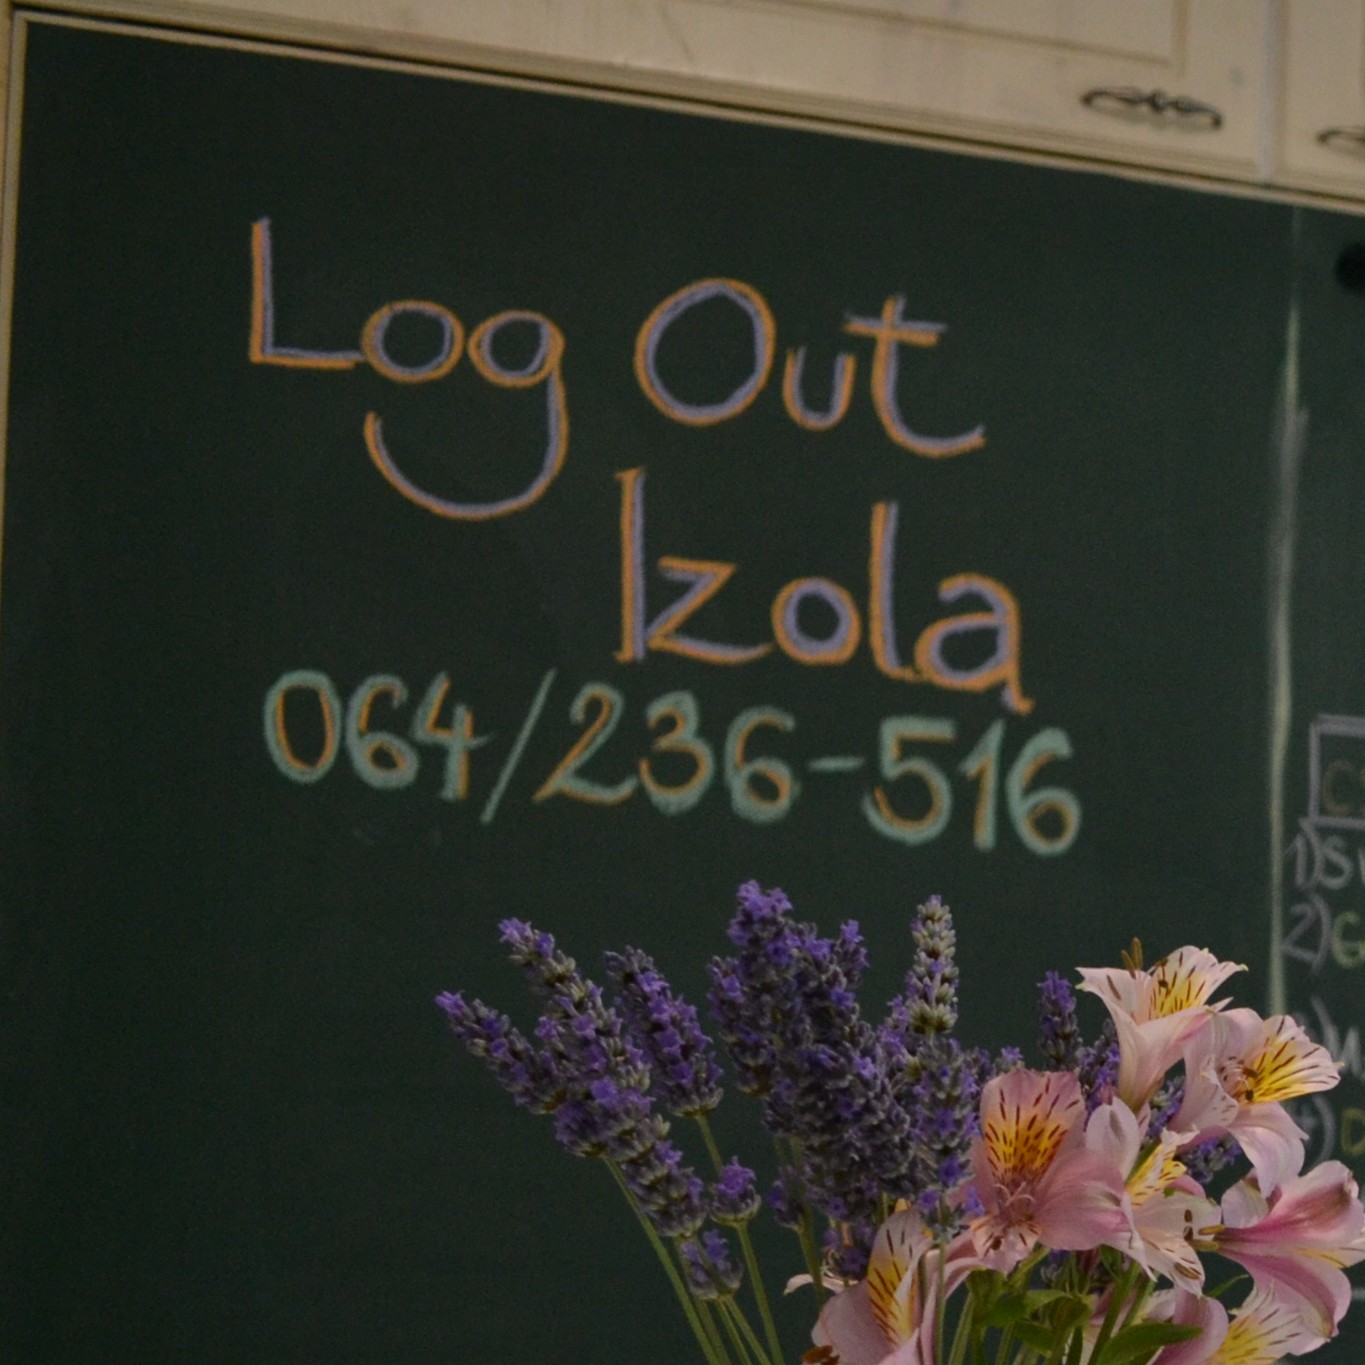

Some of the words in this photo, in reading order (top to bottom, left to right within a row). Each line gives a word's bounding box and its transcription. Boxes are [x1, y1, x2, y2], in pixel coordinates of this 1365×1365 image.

[251, 217, 568, 519] Log
[633, 277, 985, 458] Out
[616, 466, 1035, 715] Izola
[264, 668, 1082, 857] 064/236-516
